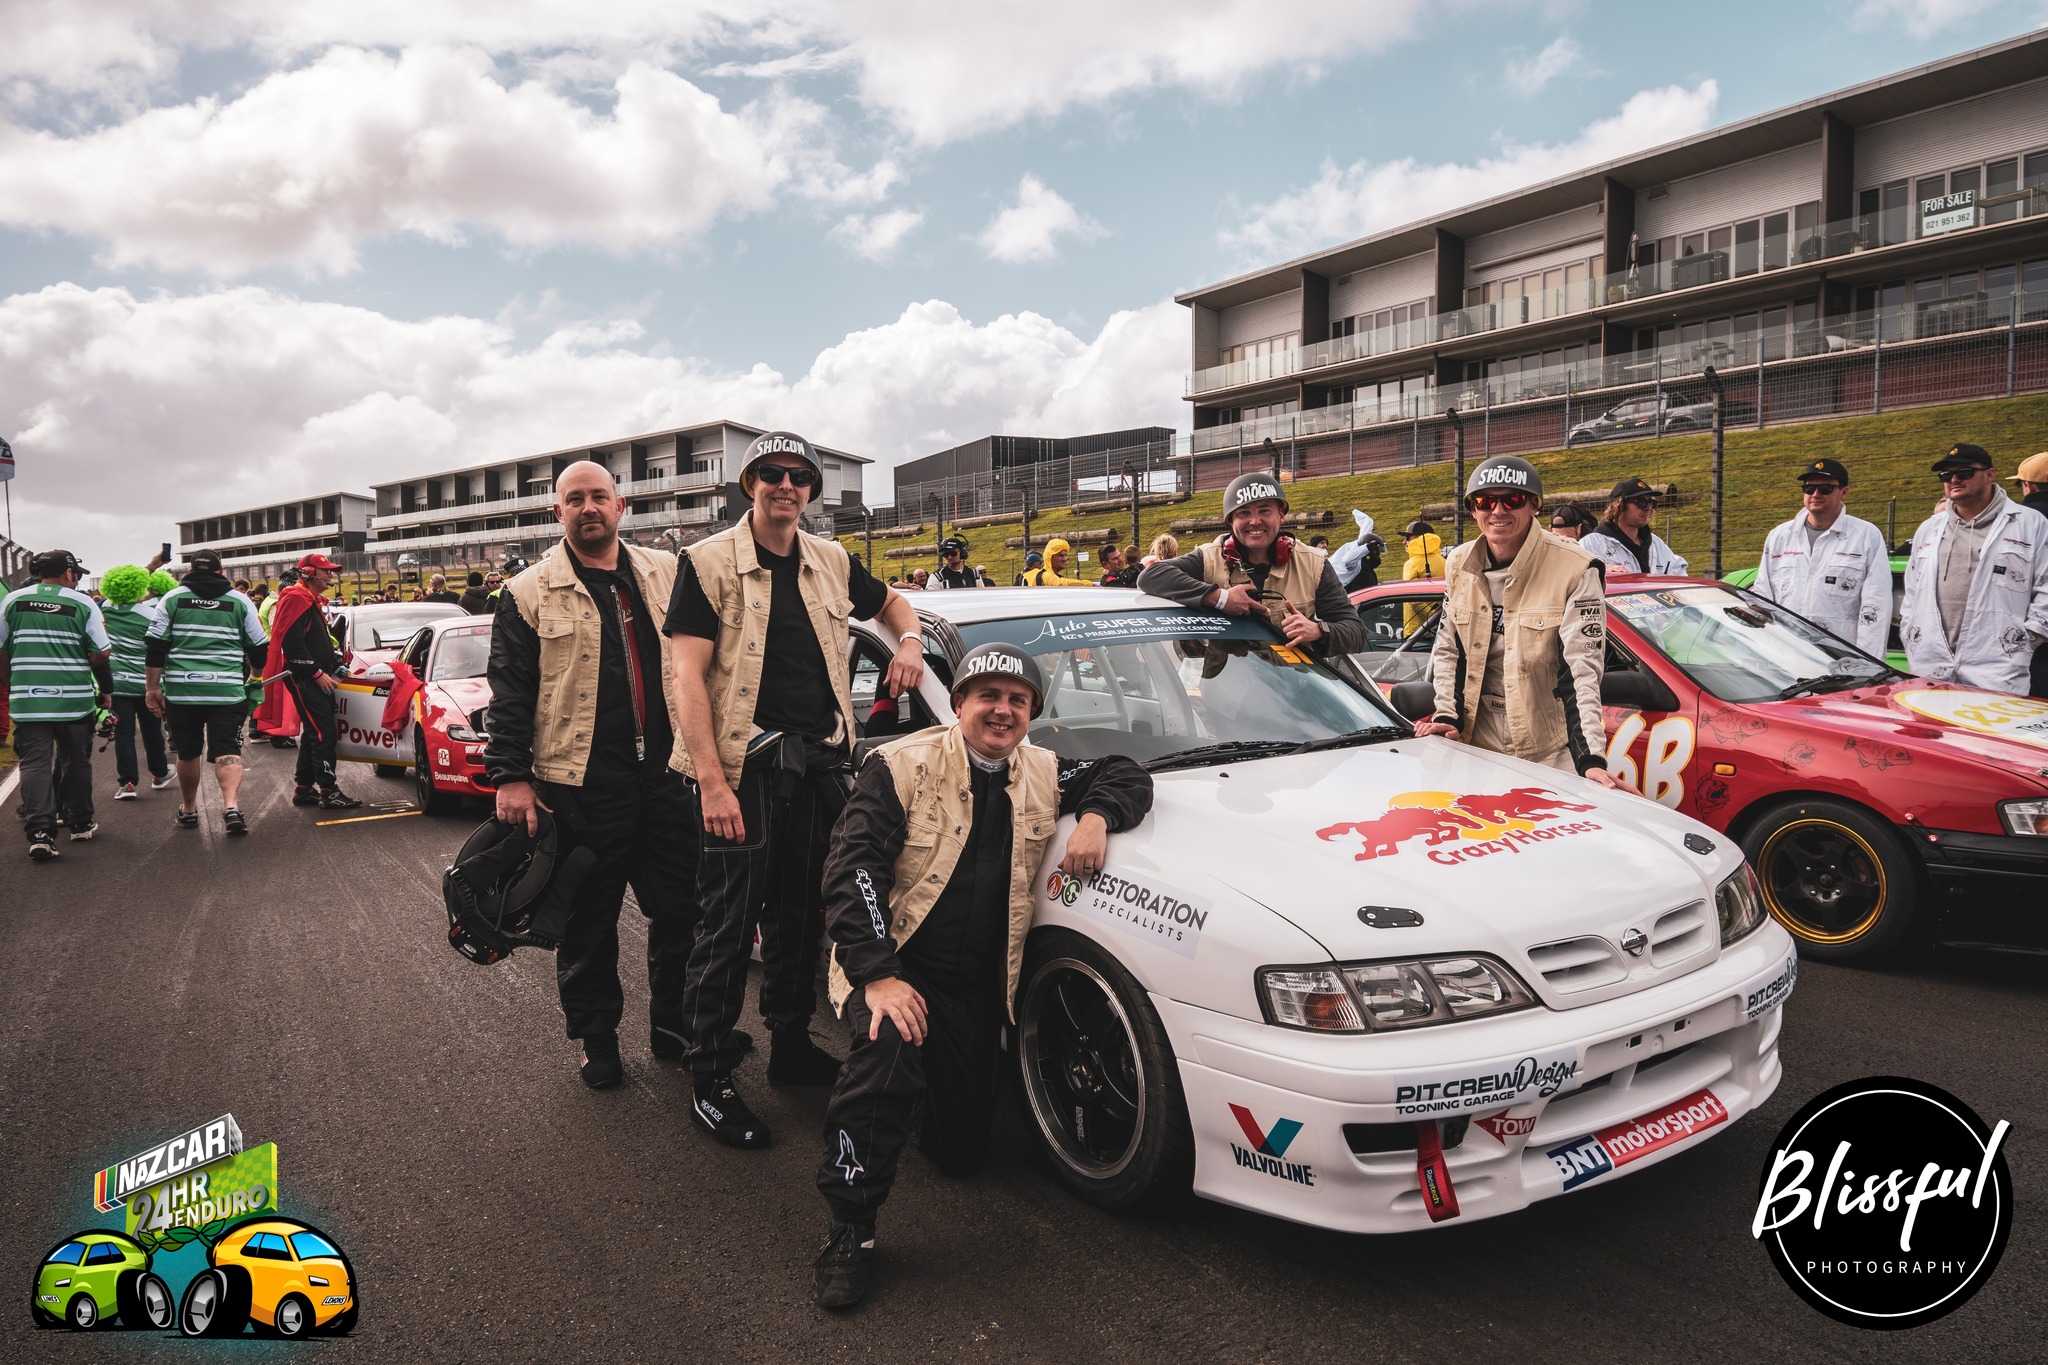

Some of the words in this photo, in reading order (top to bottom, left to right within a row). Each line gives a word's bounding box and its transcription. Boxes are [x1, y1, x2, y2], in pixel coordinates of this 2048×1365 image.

[1924, 200, 1945, 213] FOR
[1947, 191, 1972, 208] SALE
[1925, 221, 1939, 230] 021
[1941, 217, 1954, 226] 951
[1956, 212, 1971, 223] 362
[29, 601, 61, 611] HYNDS
[1024, 619, 1087, 646] Auto
[1091, 617, 1151, 630] SUPER
[1155, 615, 1232, 627] SHOPPES
[1084, 627, 1129, 638] PREMIUM
[1130, 624, 1187, 635] AUTOMOTIVE
[1187, 624, 1226, 632] CENTRES
[1602, 713, 1696, 811] 6B
[1087, 870, 1208, 931] RESTORATION
[1093, 898, 1183, 941] SPECIALISTS
[1514, 1056, 1577, 1098] Design
[1396, 1099, 1460, 1115] TOONING
[1464, 1090, 1515, 1107] GARAGE
[1492, 1117, 1536, 1135] TOW
[1550, 1140, 1606, 1182] BNT
[1606, 1094, 1722, 1157] motorsport
[1230, 1142, 1315, 1187] VALVOLINE
[1425, 1168, 1440, 1205] Racetech
